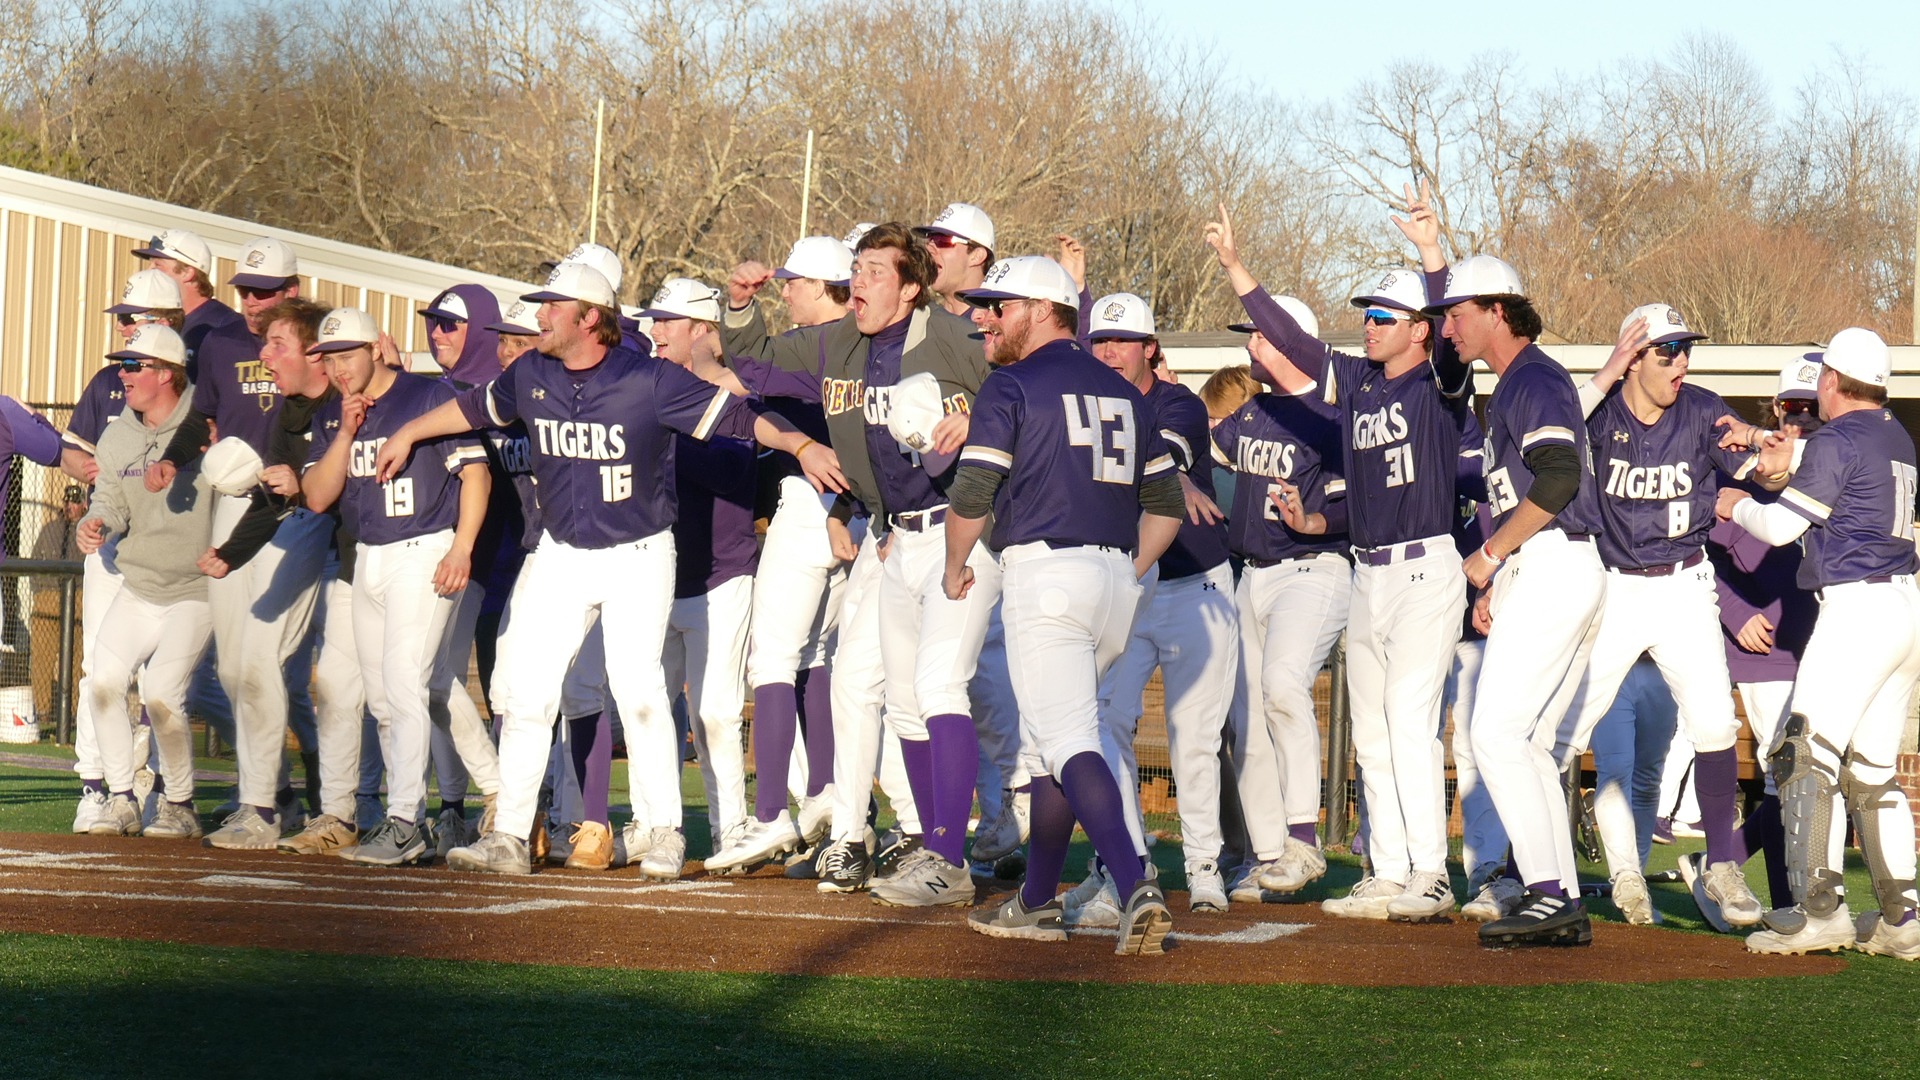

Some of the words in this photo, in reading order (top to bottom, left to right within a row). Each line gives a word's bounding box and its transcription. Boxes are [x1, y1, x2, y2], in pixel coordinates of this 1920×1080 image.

[534, 417, 626, 461] TIGERS
[1061, 393, 1137, 485] 43
[1236, 435, 1296, 480] TIGERS
[599, 463, 633, 503] 16
[1384, 442, 1415, 489] 31
[1605, 457, 1693, 500] TIGERS
[382, 477, 414, 518] 19
[1668, 501, 1690, 538] 8
